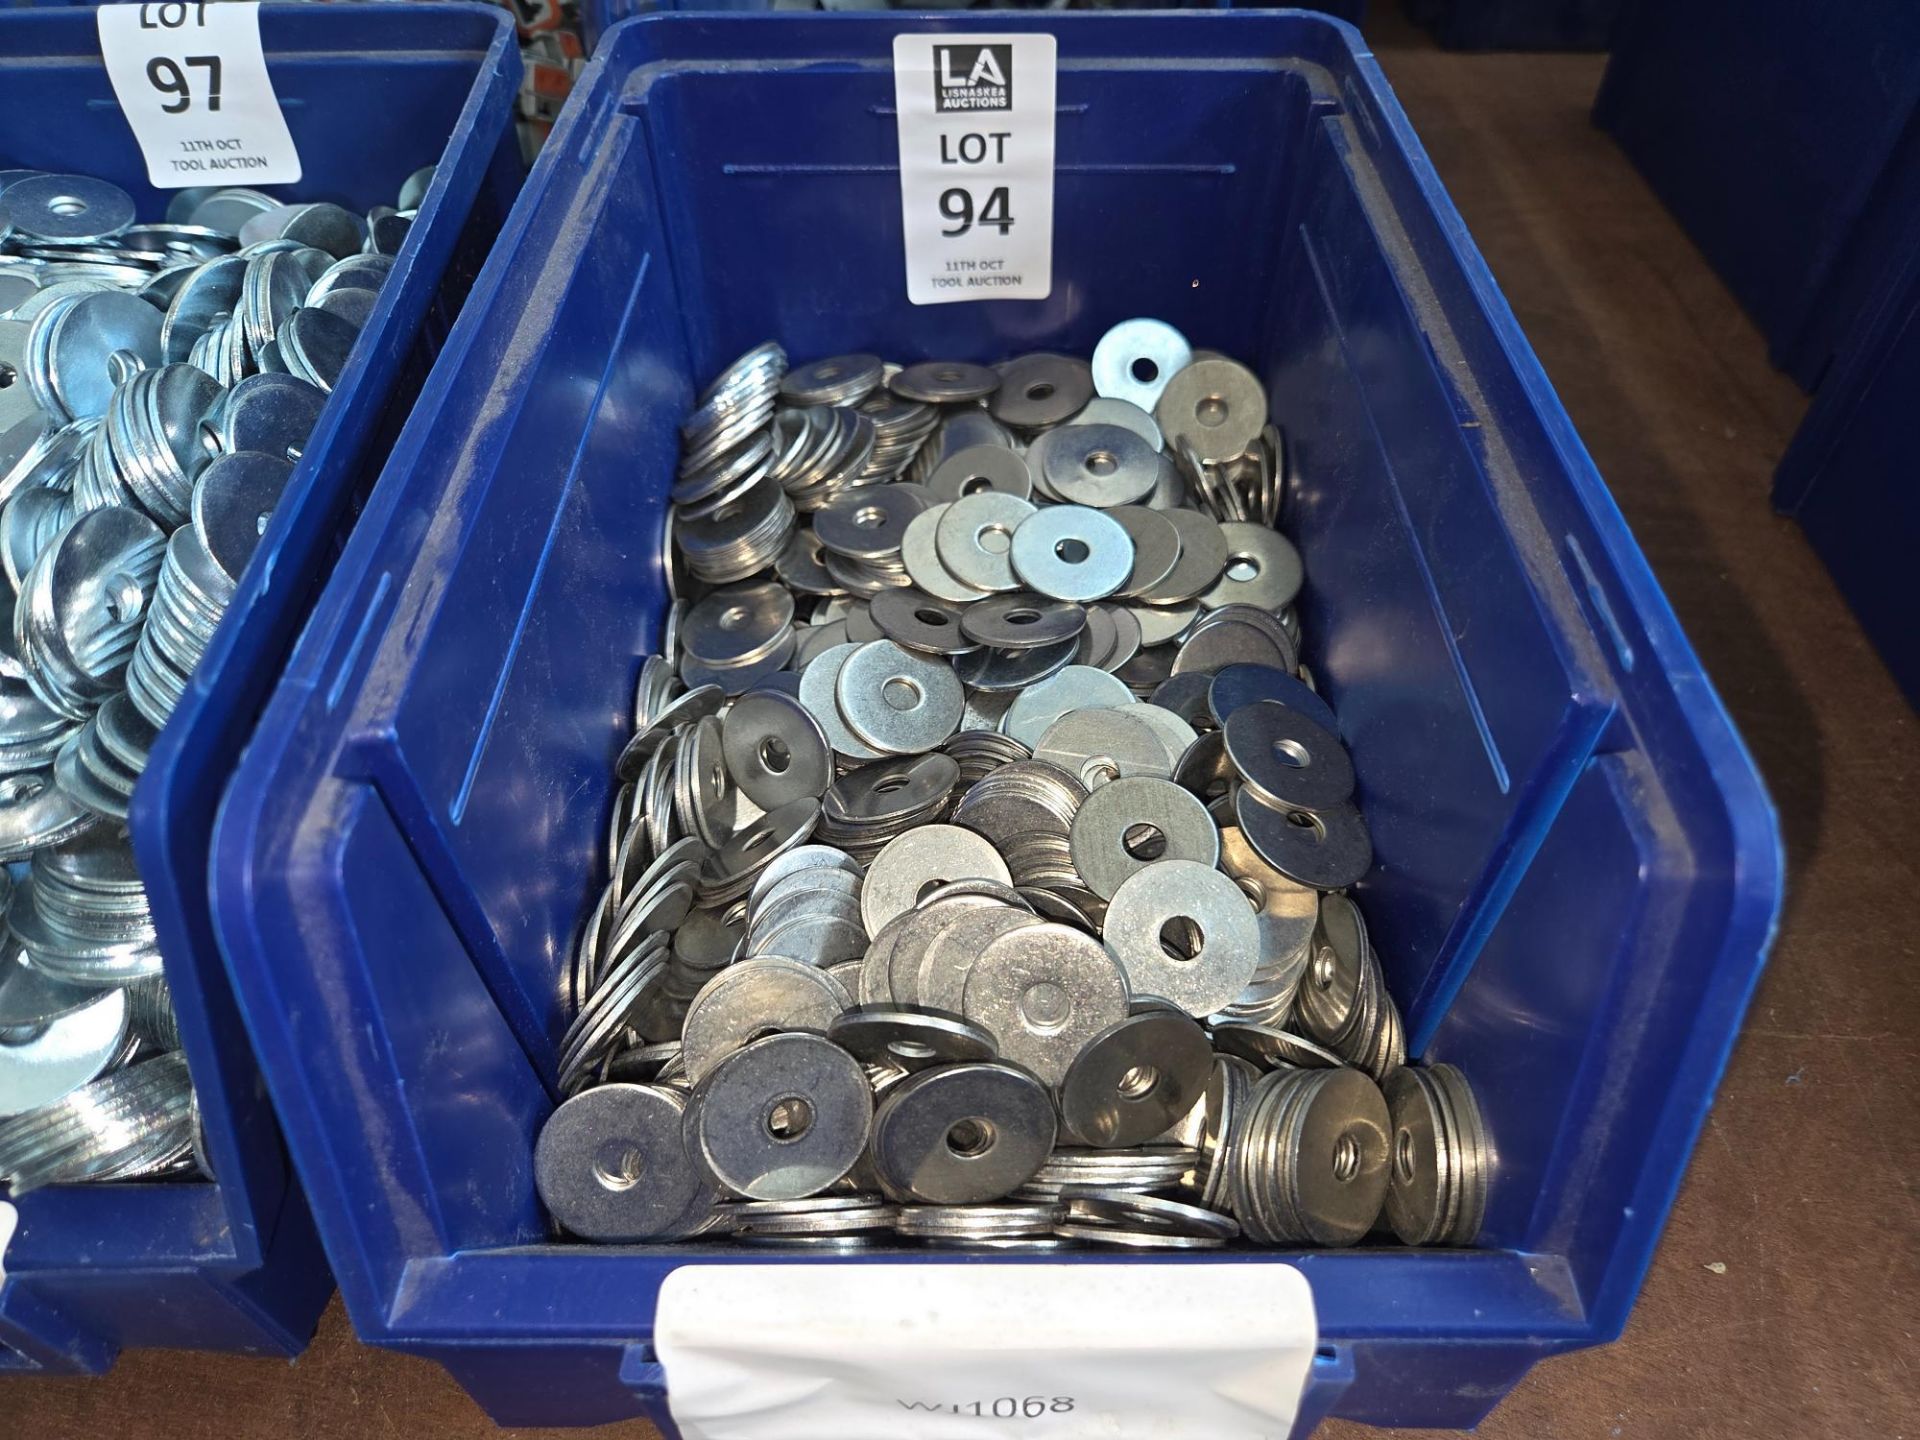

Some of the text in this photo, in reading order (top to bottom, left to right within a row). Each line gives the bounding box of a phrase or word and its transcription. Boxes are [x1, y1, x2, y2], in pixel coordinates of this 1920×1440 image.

[940, 48, 1006, 87] LA
[146, 55, 222, 114] 97
[941, 87, 1006, 98] LISNASKEA
[943, 97, 1007, 109] AUCTIONS
[180, 138, 243, 153] 11TH OCT
[939, 132, 1012, 164] LOT
[170, 156, 268, 172] TOOL AUCTION
[938, 186, 1015, 238] 94
[945, 260, 1005, 272] 11TH OCT
[931, 275, 1022, 288] TOOL AUCTION
